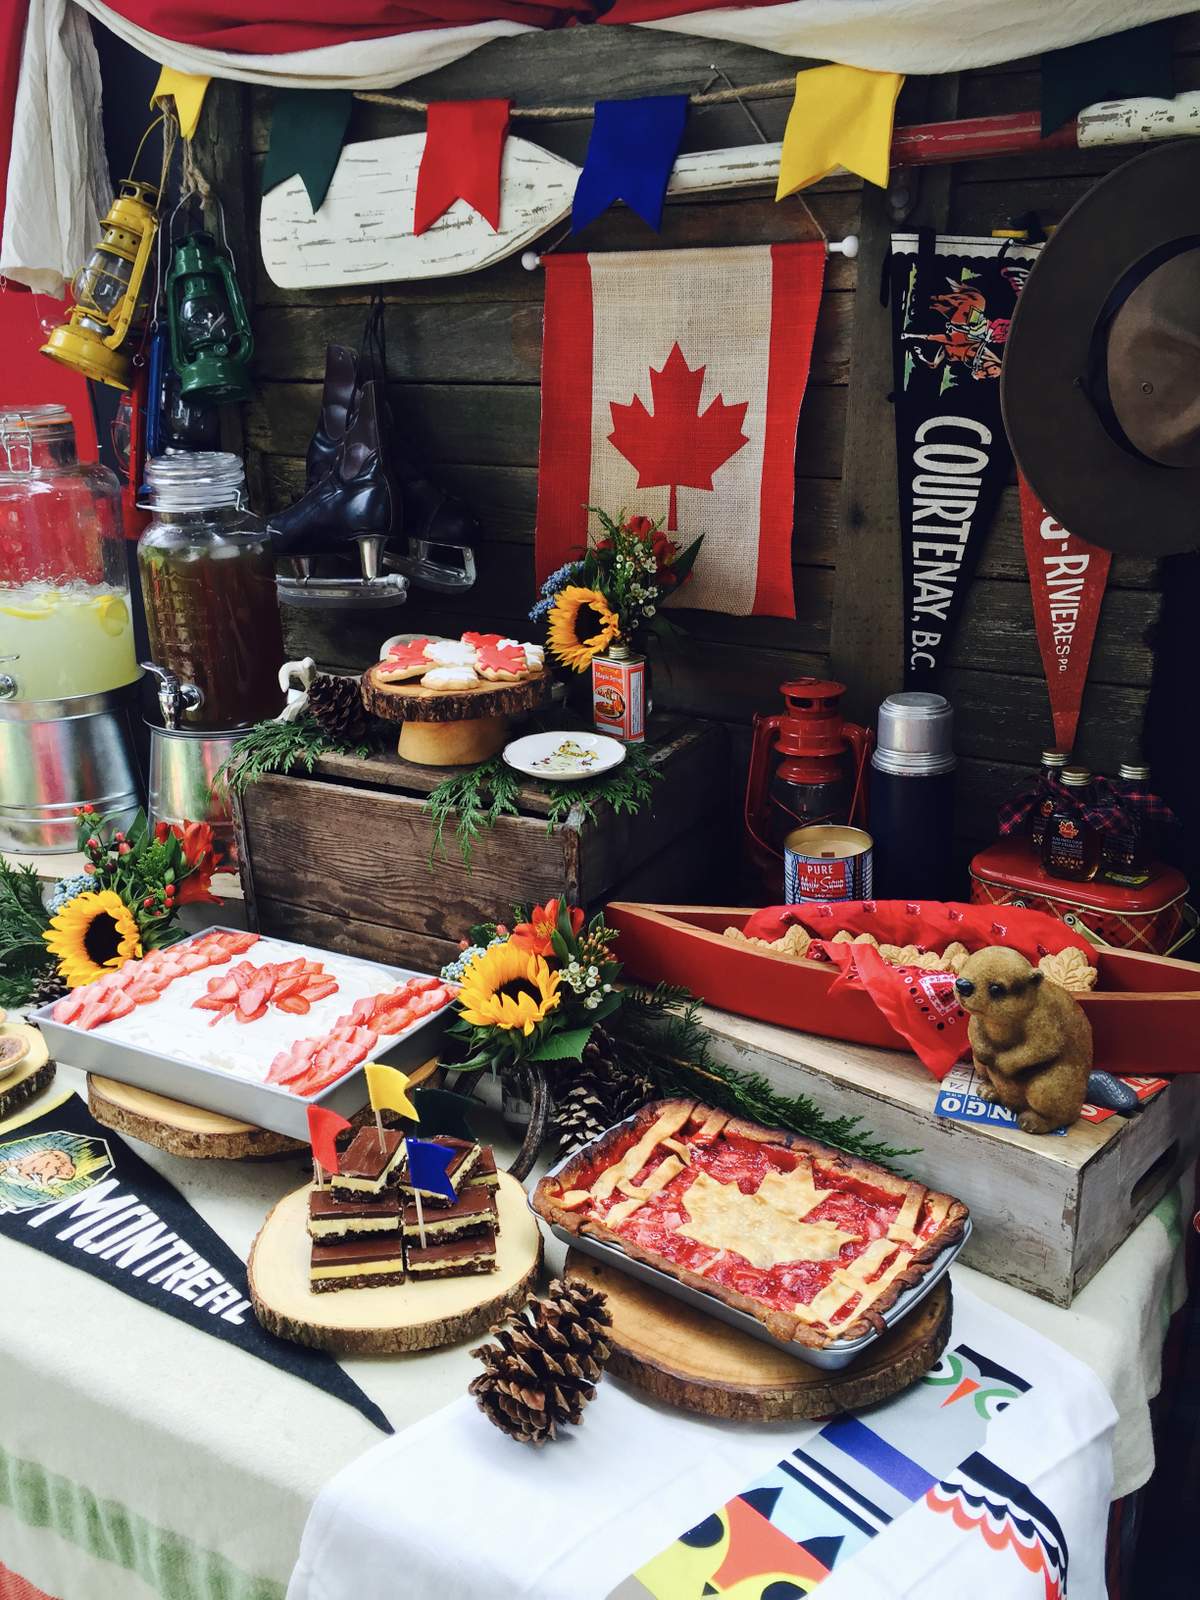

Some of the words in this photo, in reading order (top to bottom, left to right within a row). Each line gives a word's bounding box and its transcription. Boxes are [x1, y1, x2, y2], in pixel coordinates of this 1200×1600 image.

[911, 415, 992, 622] COURTENAY,
[910, 630, 941, 671] B.C.
[807, 864, 834, 875] PURE
[27, 1178, 253, 1326] MONTREAL
